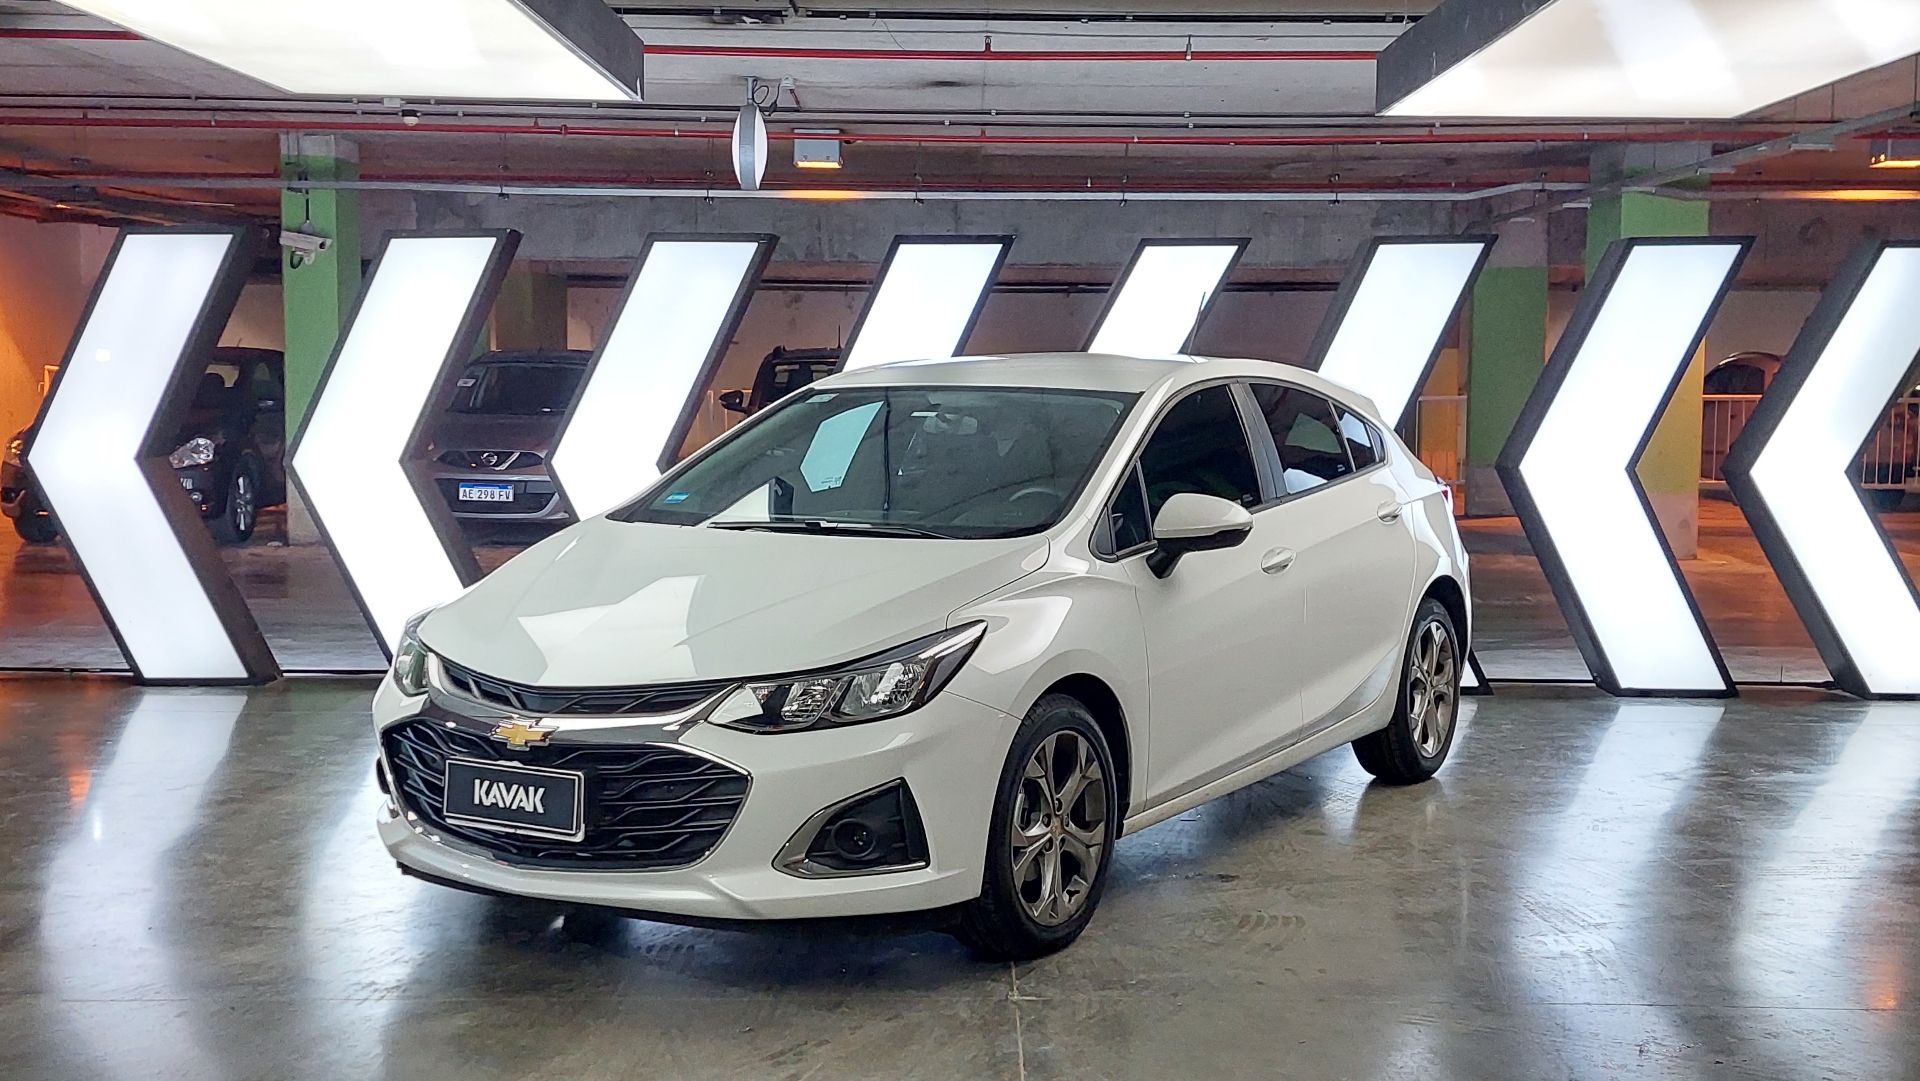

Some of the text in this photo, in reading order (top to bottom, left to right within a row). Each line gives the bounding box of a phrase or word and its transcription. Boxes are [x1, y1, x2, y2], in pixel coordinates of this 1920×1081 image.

[462, 489, 511, 500] AE 298 FV
[473, 779, 546, 814] KAVAK
